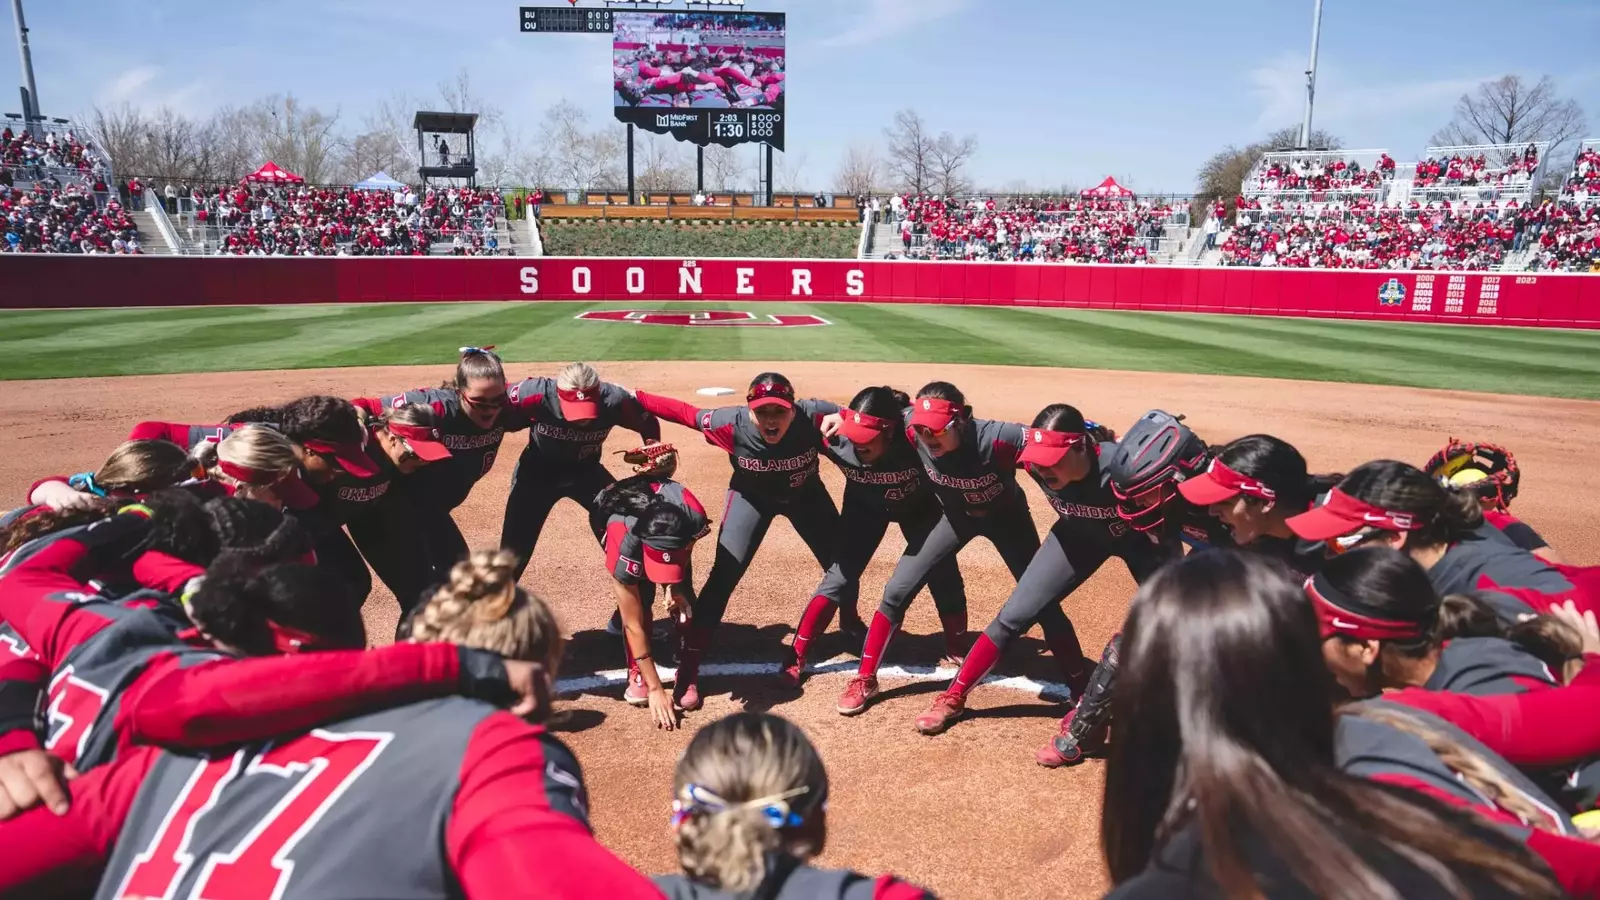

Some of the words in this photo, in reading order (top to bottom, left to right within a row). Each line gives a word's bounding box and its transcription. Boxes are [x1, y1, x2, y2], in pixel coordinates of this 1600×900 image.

[714, 124, 744, 137] 1:30
[520, 266, 864, 296] SOONERS
[113, 728, 395, 900] 17
